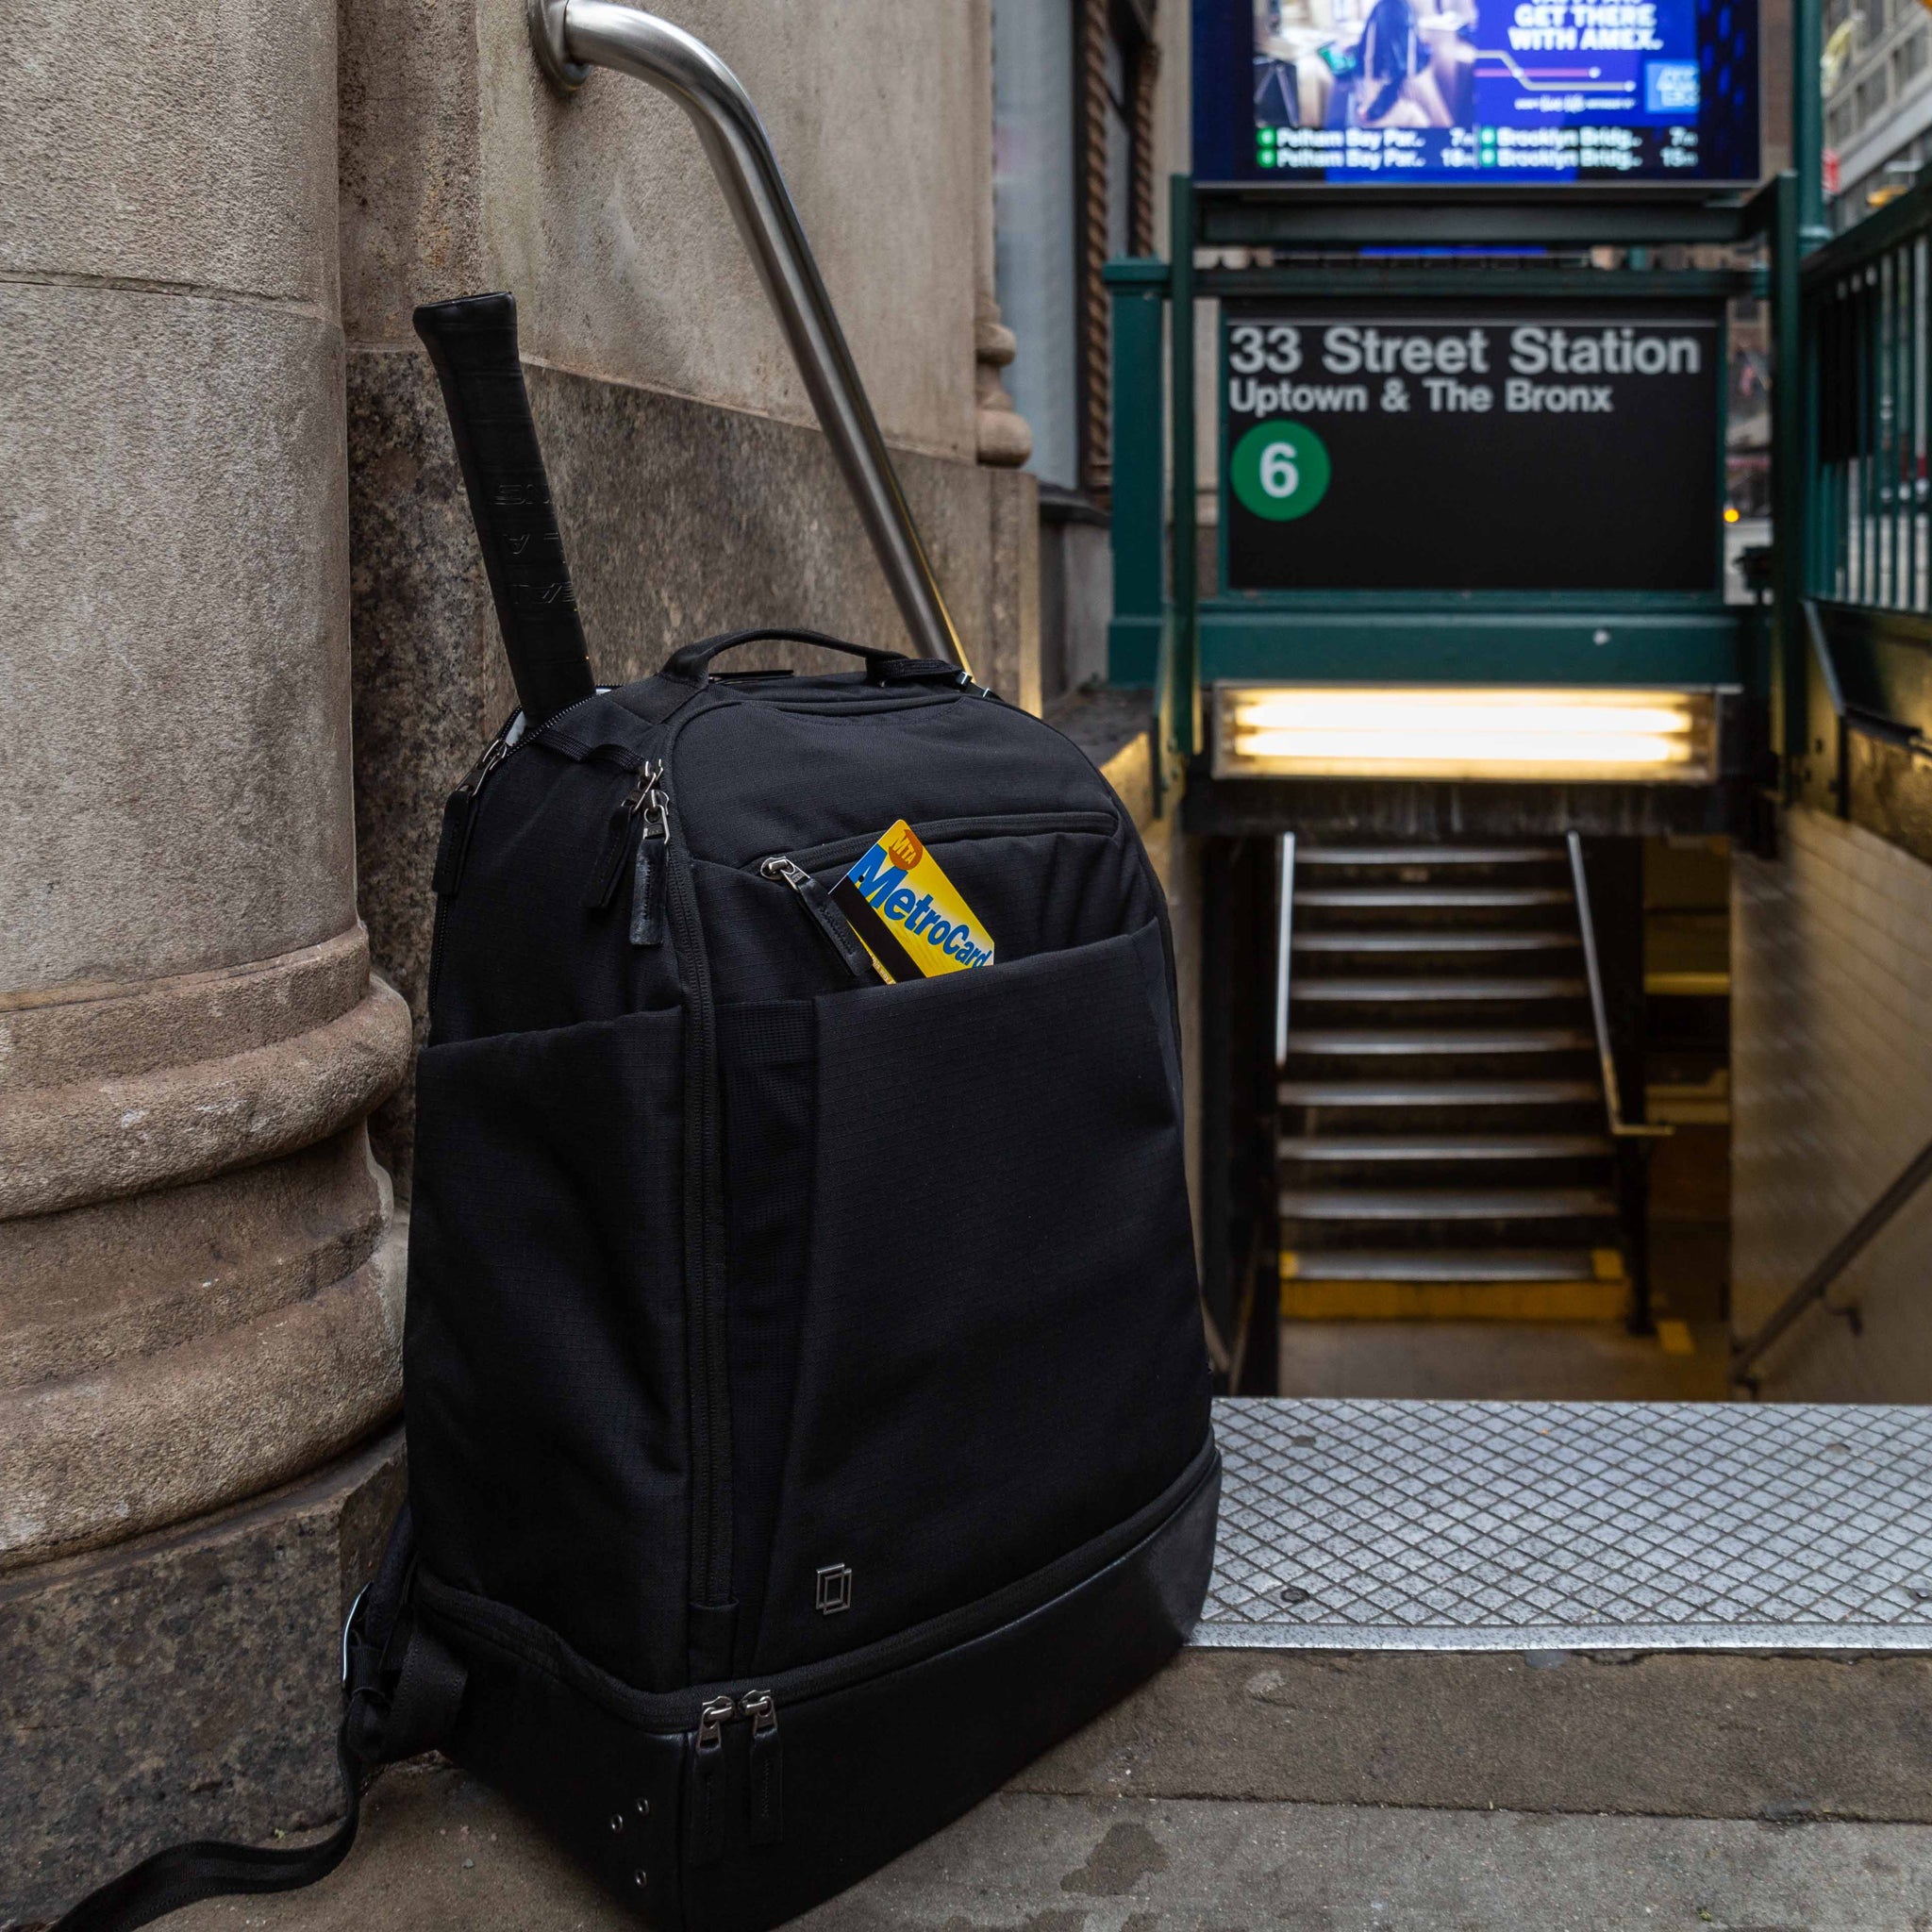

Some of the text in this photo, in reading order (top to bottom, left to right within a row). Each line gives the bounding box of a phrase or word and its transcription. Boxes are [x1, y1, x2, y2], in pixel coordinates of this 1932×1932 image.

[1508, 27, 1577, 50] WITH
[1277, 128, 1344, 147] Pelham
[1346, 128, 1383, 150] Bay
[1497, 127, 1578, 150] Brooklyn
[1277, 148, 1344, 167] Pelham
[1346, 148, 1383, 170] Bay
[1497, 148, 1578, 170] Brooklyn
[1229, 326, 1700, 374] 33 Street Station
[1229, 378, 1614, 417] Uptown & The Bronx
[1258, 441, 1299, 498] 6
[890, 836, 917, 865] MTA
[847, 843, 992, 968] MetroCard
